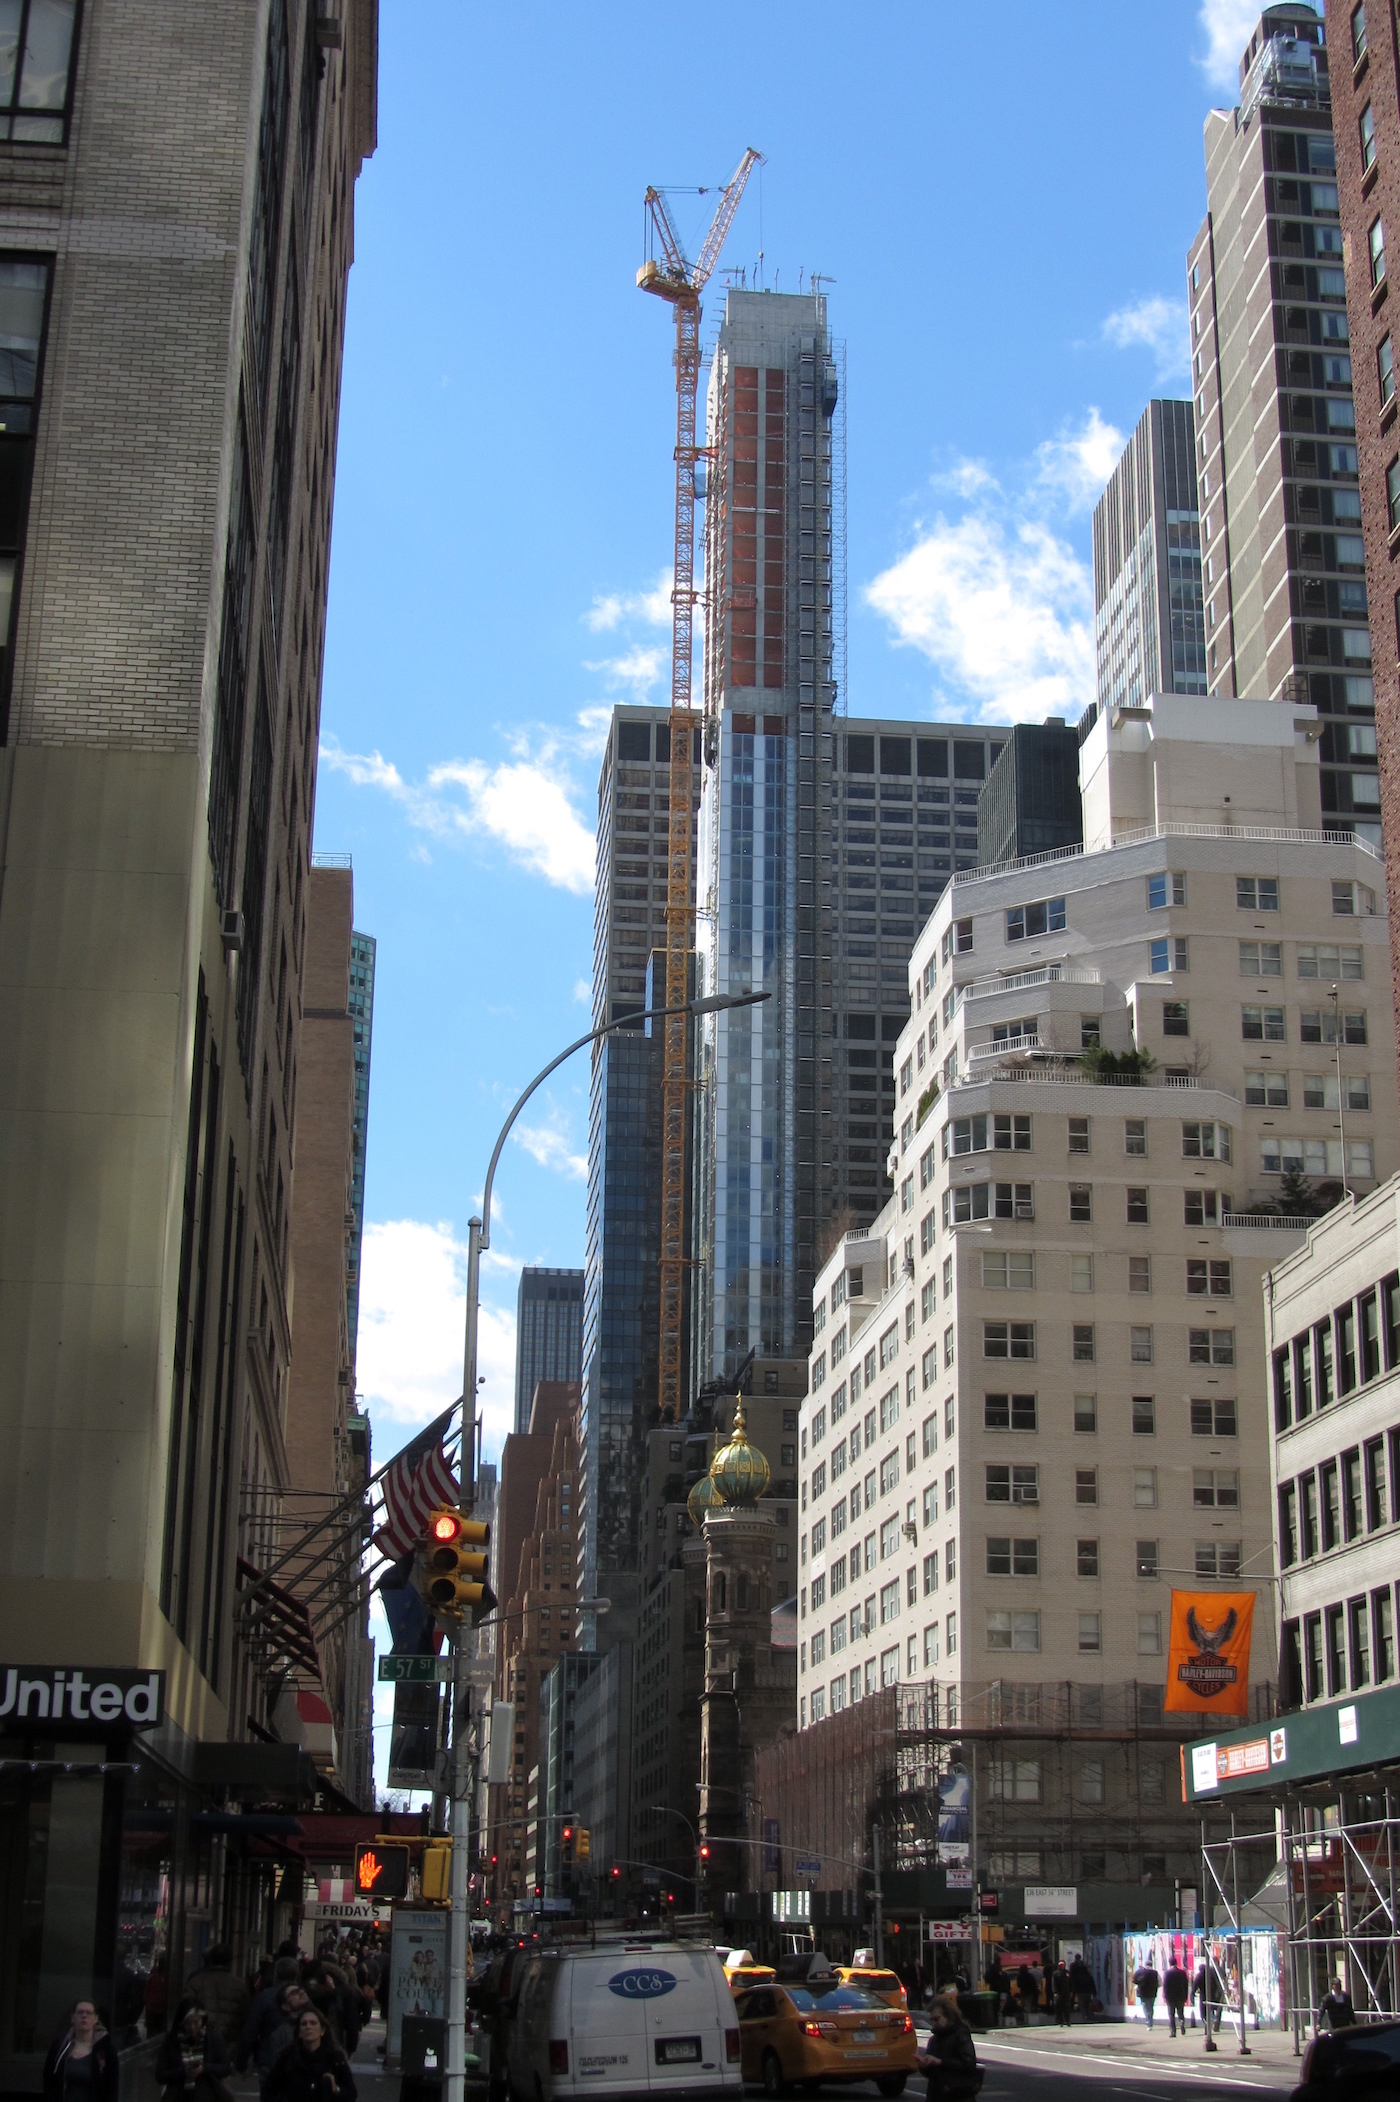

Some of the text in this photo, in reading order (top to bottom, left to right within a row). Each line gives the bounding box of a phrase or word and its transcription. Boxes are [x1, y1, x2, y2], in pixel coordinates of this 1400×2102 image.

[1194, 1656, 1221, 1666] MOTOR
[381, 1659, 433, 1679] E 57 ST
[1193, 1682, 1221, 1694] CYCLES
[622, 1974, 663, 1993] CCS
